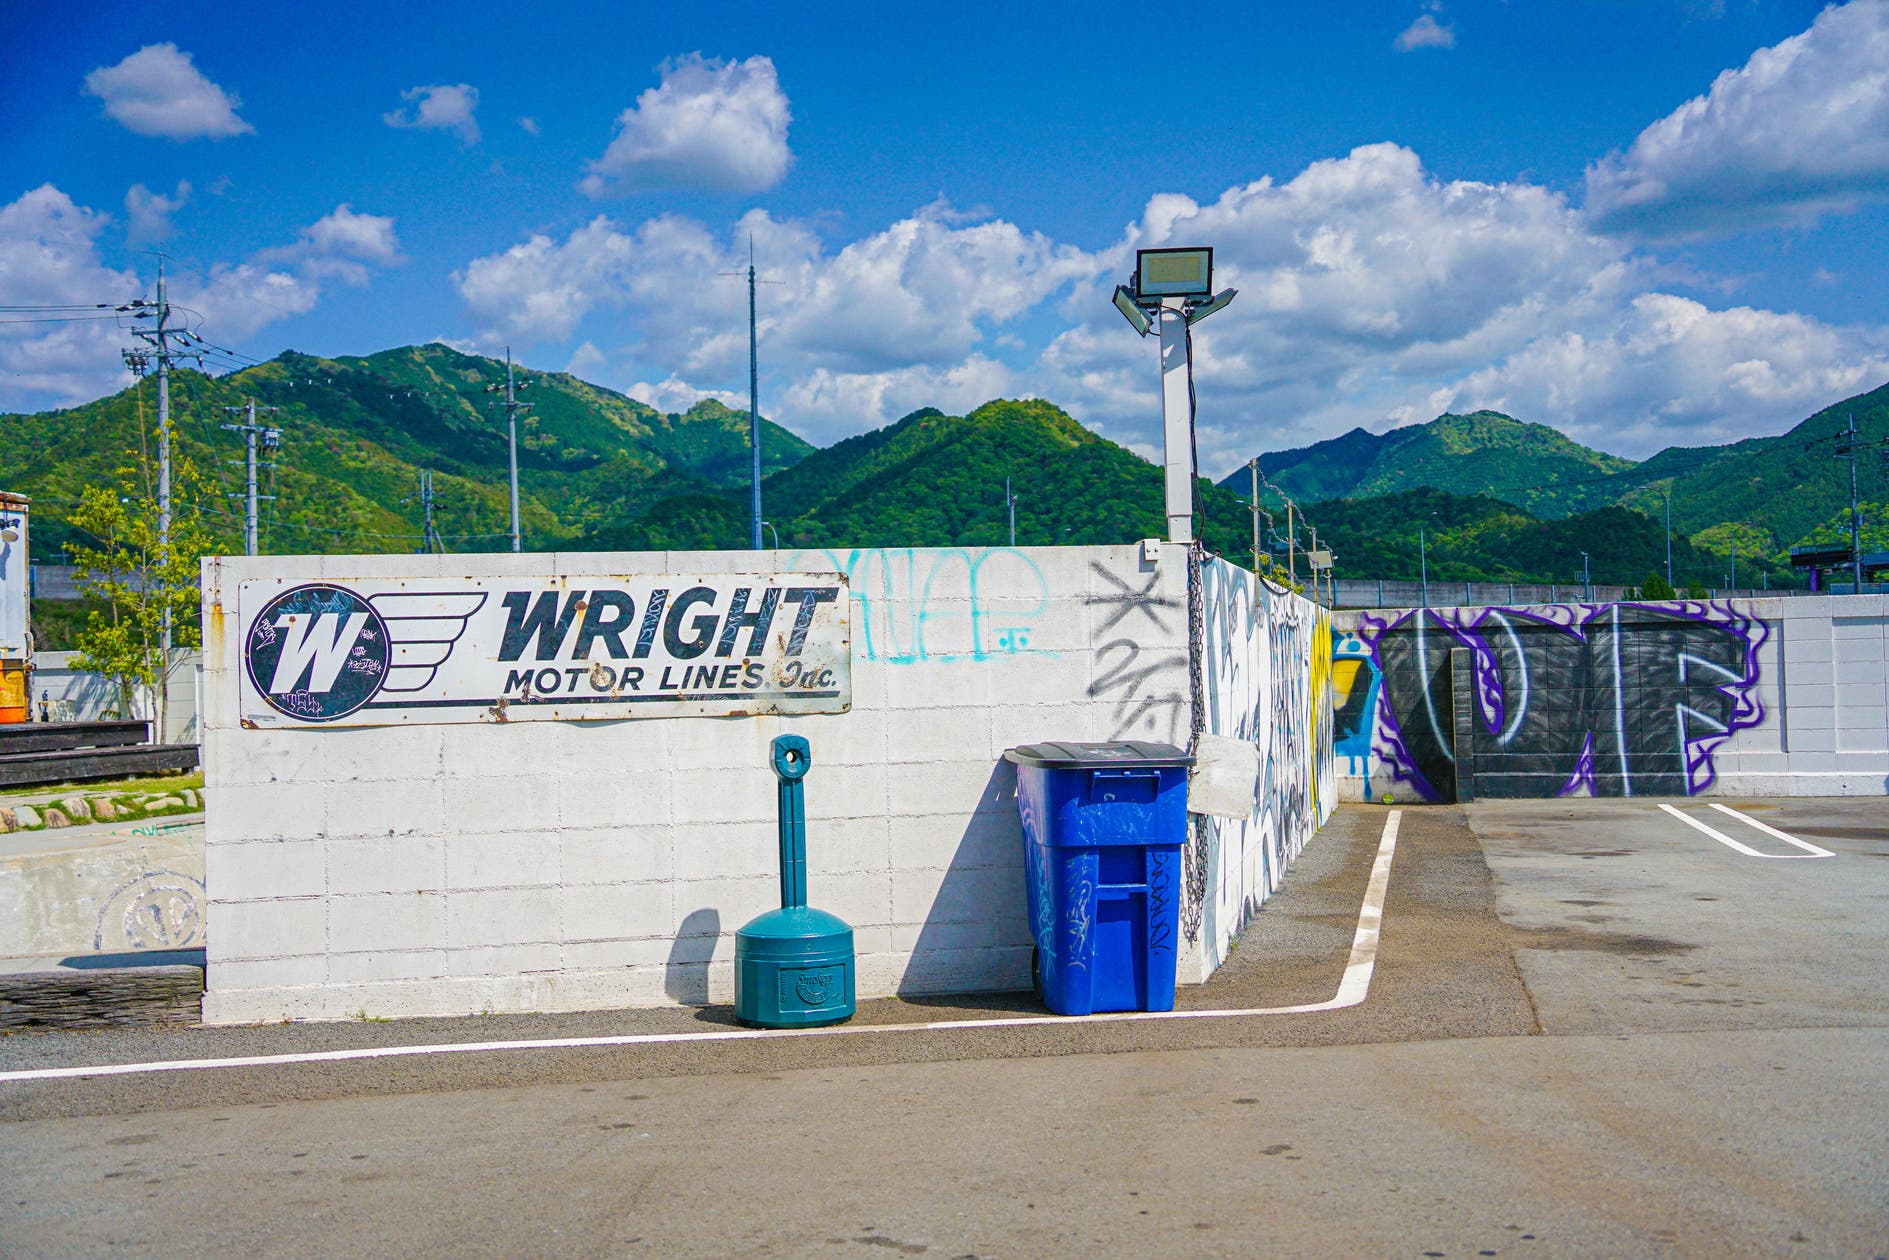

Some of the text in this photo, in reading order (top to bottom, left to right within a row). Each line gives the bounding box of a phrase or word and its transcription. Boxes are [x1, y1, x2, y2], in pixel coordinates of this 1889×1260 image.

[268, 612, 370, 694] W
[497, 587, 840, 662] WRIGHT
[503, 665, 645, 694] MOTOR
[779, 660, 837, 689] Inc.
